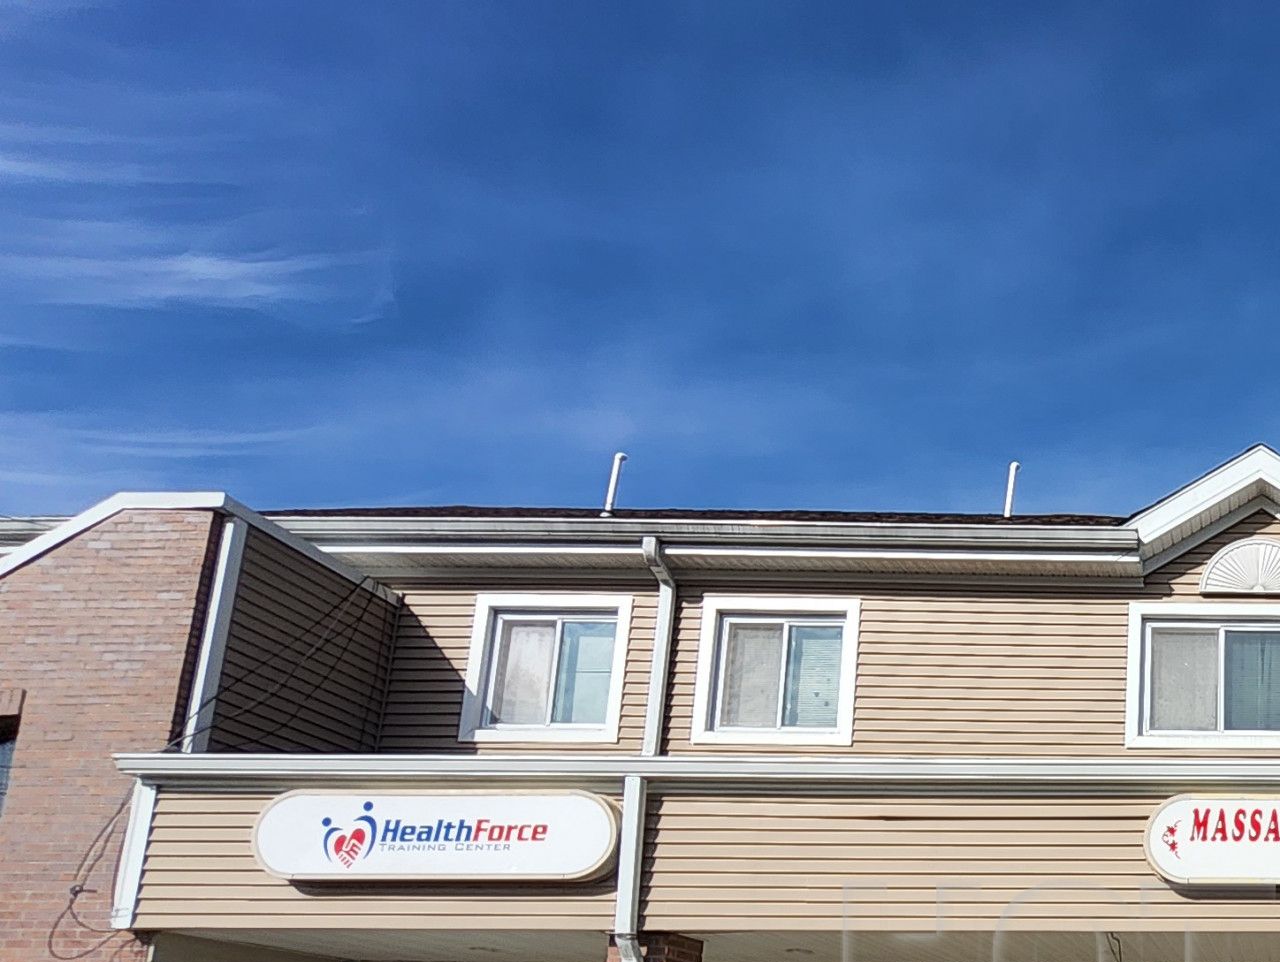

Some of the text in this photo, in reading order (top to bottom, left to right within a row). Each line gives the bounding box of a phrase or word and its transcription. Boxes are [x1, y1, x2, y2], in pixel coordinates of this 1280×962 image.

[380, 818, 548, 842] HealthForce
[378, 842, 511, 852] TRAINING CENTER
